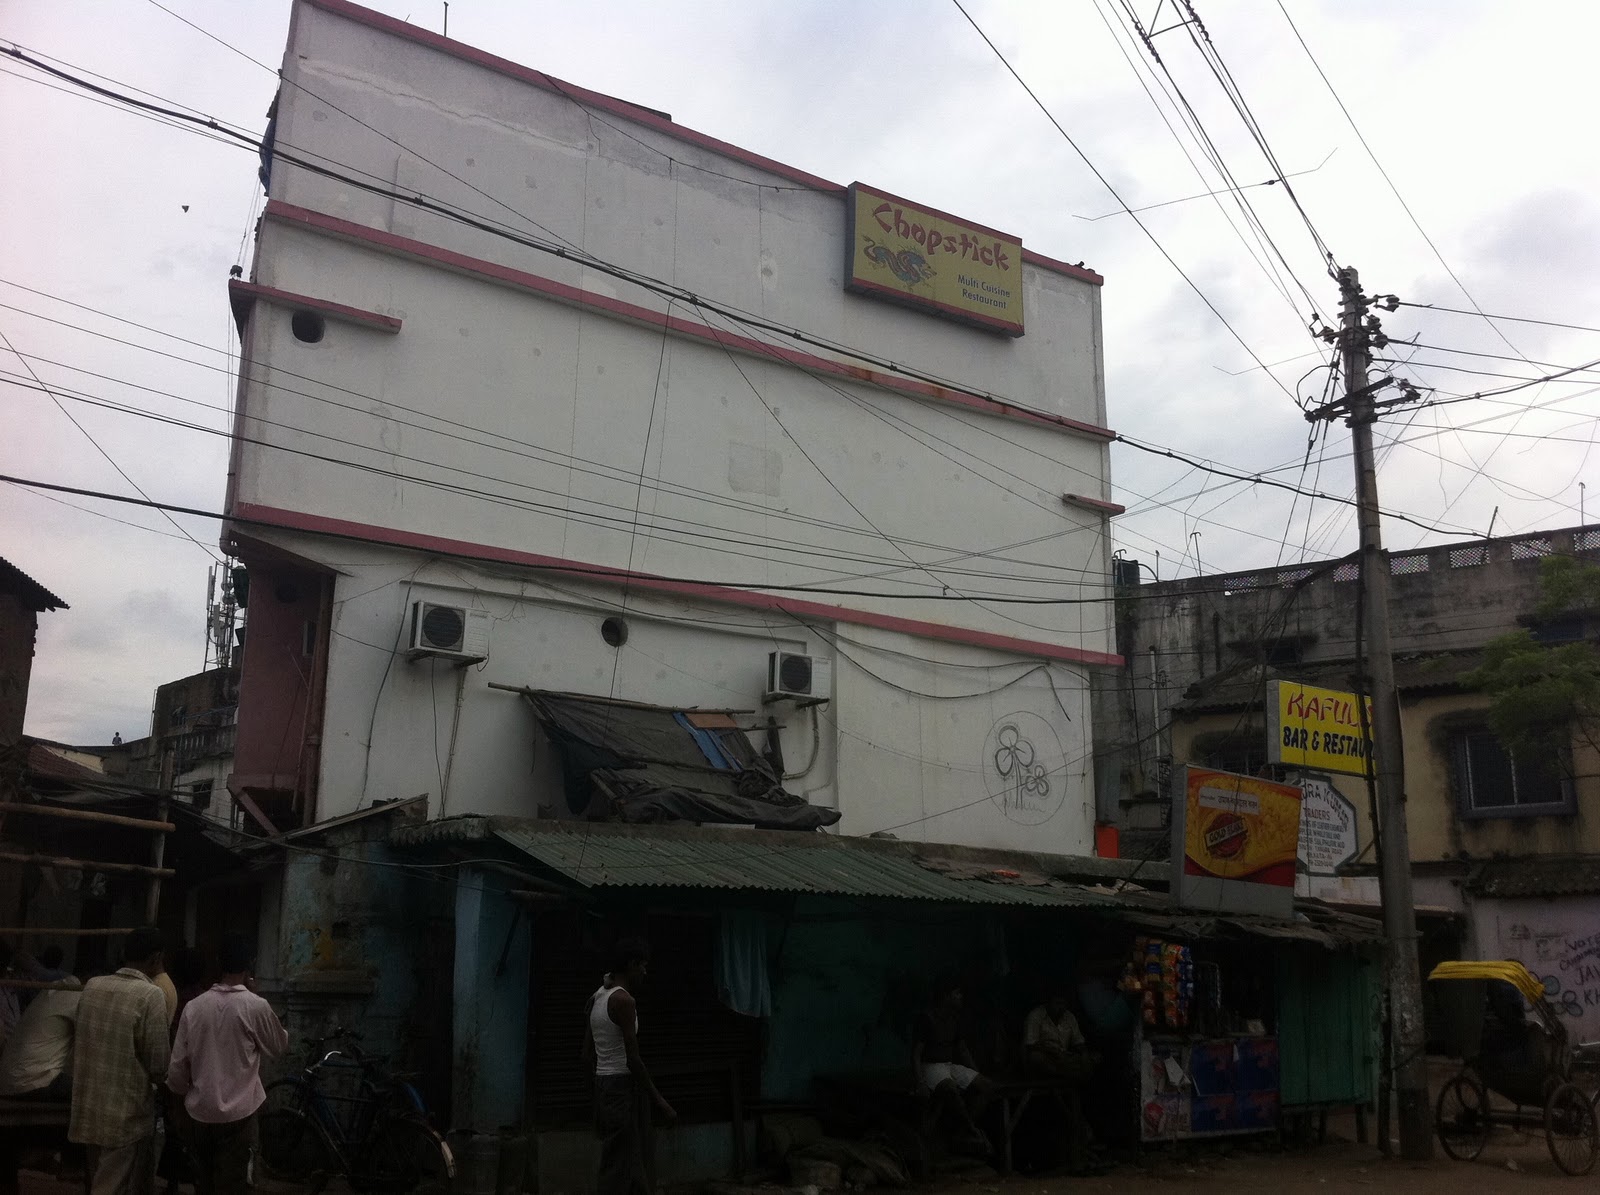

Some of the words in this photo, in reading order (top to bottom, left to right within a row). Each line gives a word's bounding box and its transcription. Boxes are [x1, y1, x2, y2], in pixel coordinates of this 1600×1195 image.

[872, 203, 1010, 272] Chopstick
[958, 274, 979, 290] Multi
[981, 281, 1011, 298] Cuisine
[962, 288, 1007, 309] Restaurant
[1283, 726, 1308, 751] BAR
[1311, 730, 1320, 751] &
[1323, 732, 1374, 758] RESTAU
[1209, 826, 1227, 843] GOLD
